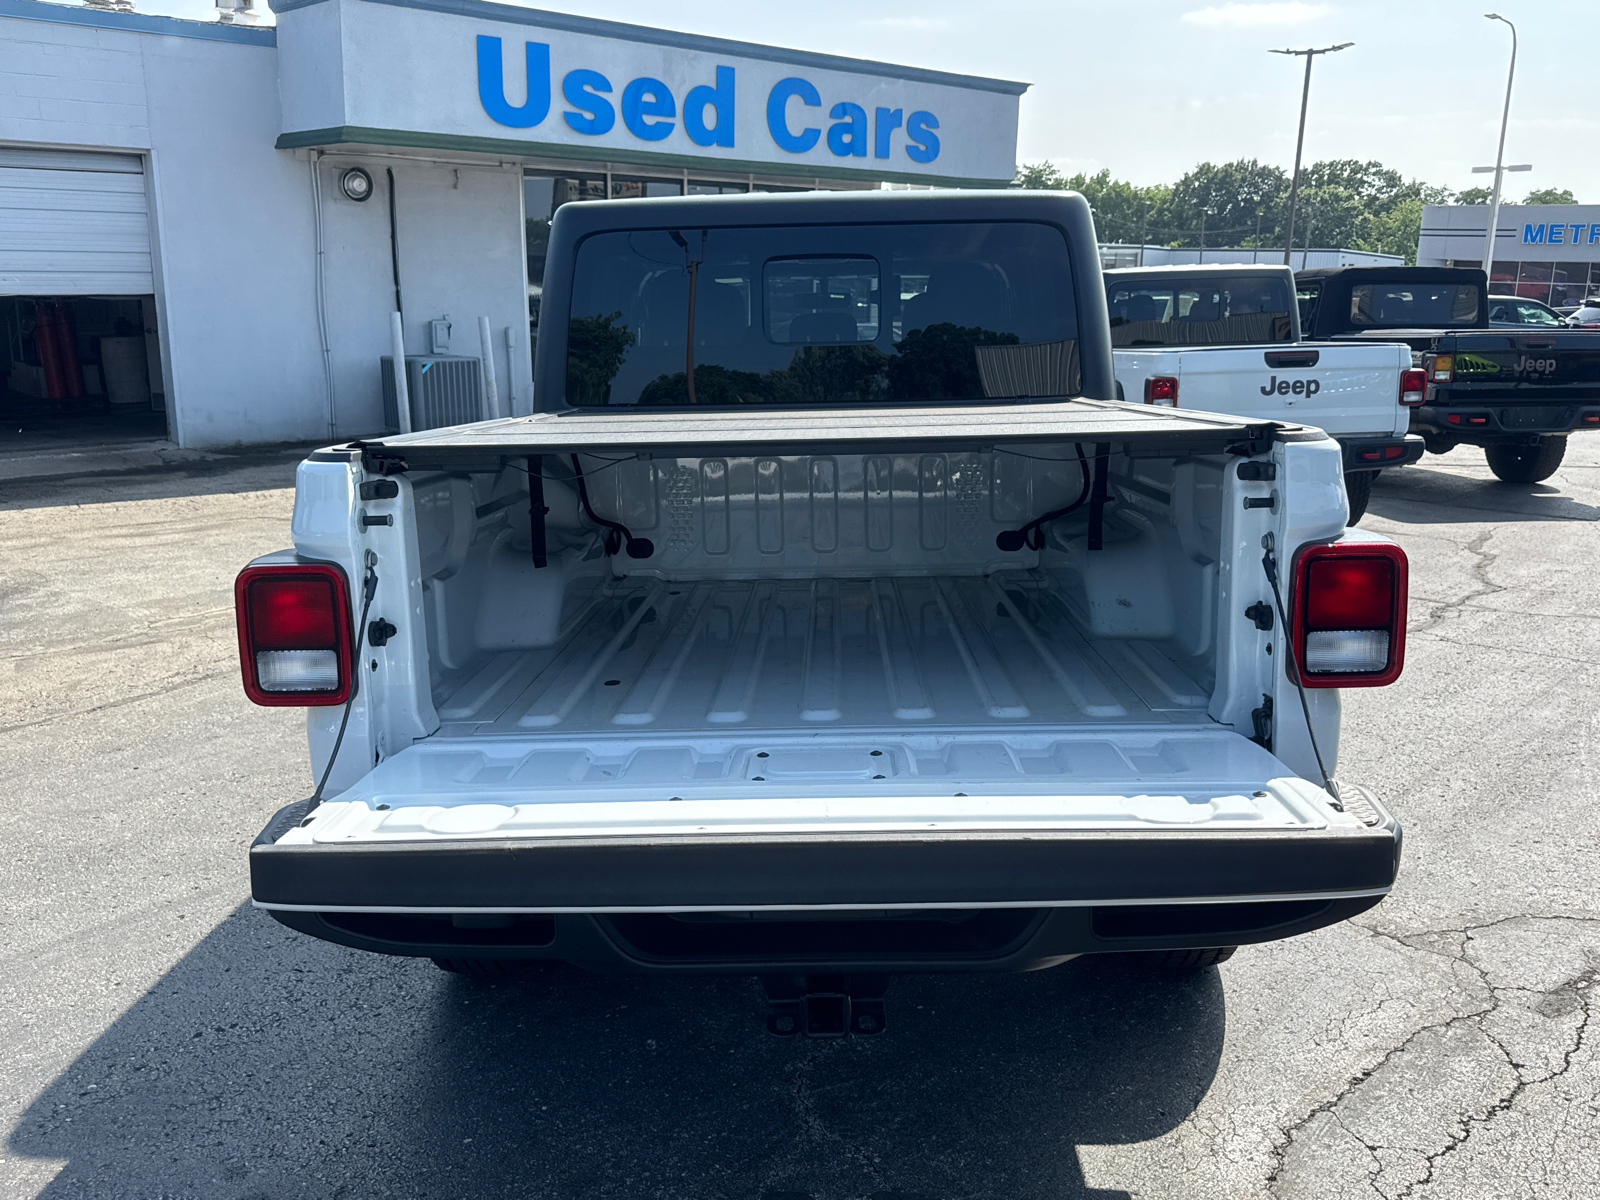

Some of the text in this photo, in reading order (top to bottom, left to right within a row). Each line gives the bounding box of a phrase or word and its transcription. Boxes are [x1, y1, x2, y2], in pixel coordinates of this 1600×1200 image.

[476, 34, 941, 164] Used Cars
[1522, 222, 1600, 245] METR
[1513, 355, 1557, 375] Jeep
[1260, 375, 1320, 399] Jeep
